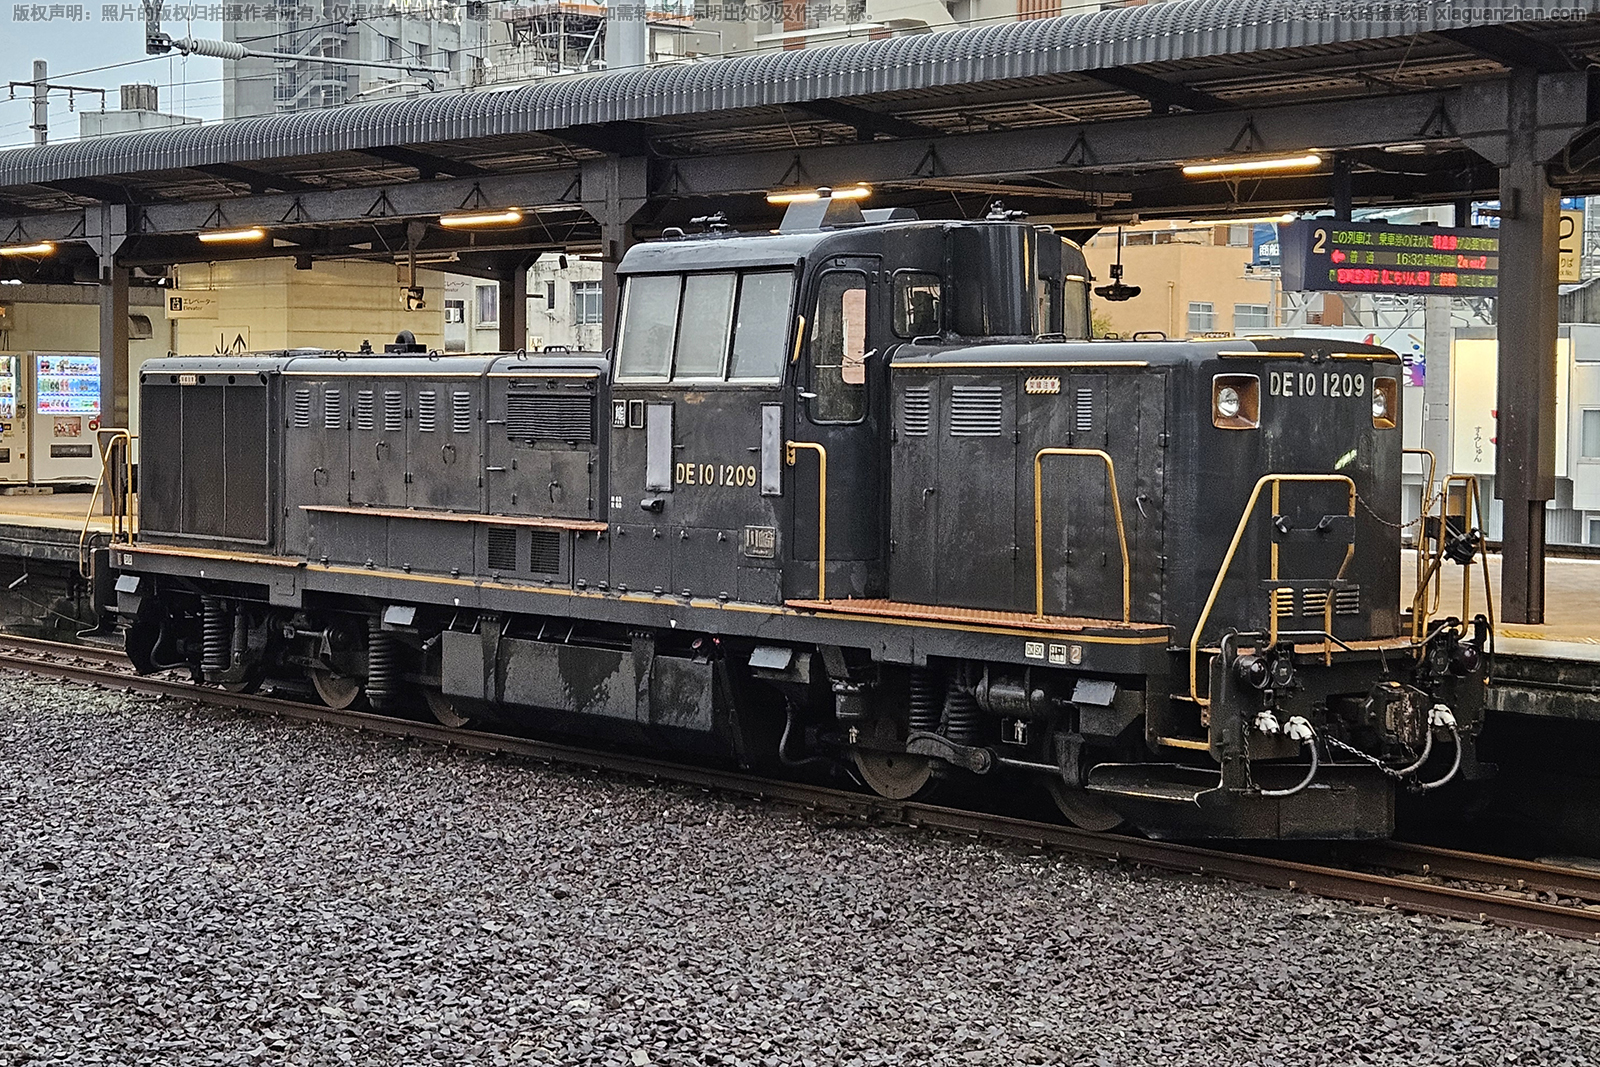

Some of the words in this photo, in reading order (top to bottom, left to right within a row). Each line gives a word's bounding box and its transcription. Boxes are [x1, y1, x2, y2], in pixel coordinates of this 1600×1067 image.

[1313, 228, 1327, 254] 2
[1396, 252, 1424, 266] 16:32
[1071, 647, 1080, 661] 2
